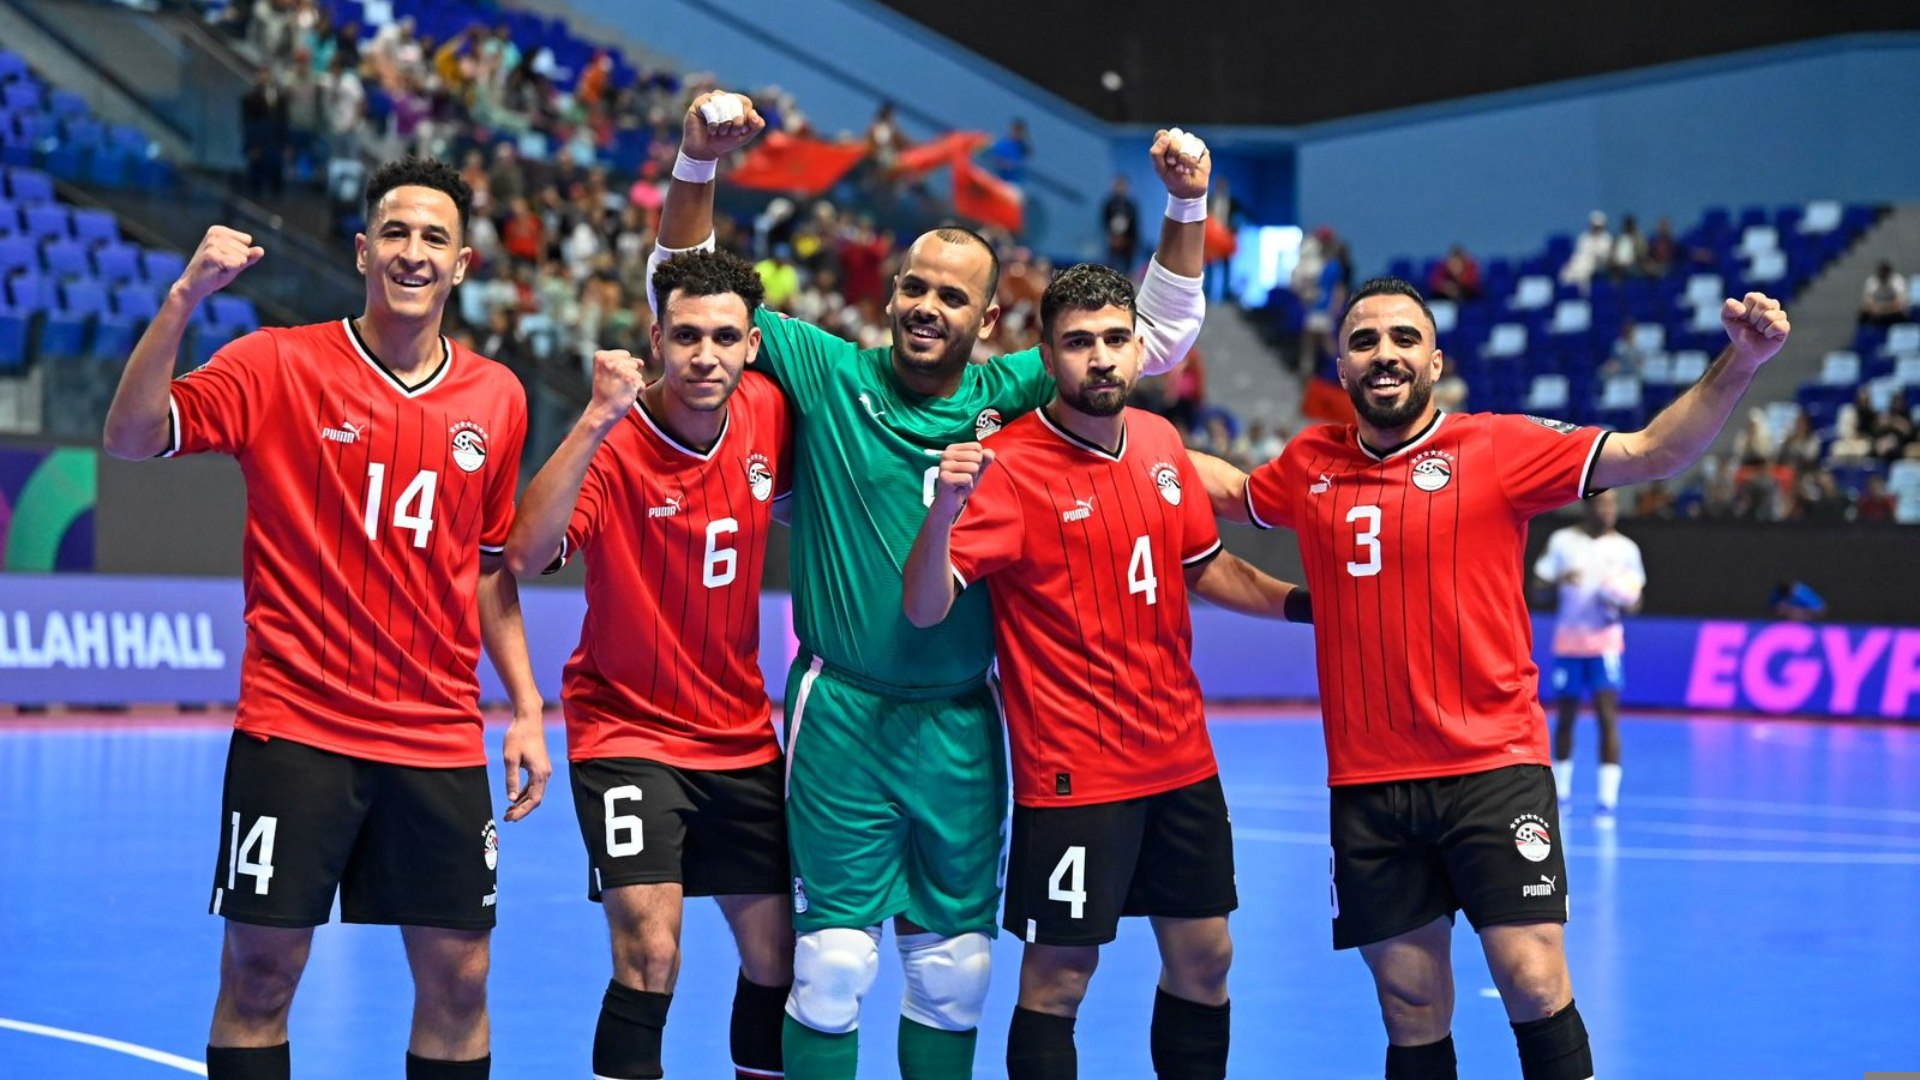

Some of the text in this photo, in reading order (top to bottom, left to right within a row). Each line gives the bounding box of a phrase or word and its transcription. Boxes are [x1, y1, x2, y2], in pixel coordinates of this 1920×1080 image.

[322, 427, 355, 444] PUMA
[365, 462, 437, 548] 14
[1346, 505, 1382, 577] 3
[703, 517, 738, 588] 6
[1128, 535, 1157, 605] 4
[111, 611, 226, 670] HALL
[228, 811, 278, 895] 14
[603, 785, 643, 858] 6
[1048, 846, 1087, 919] 4
